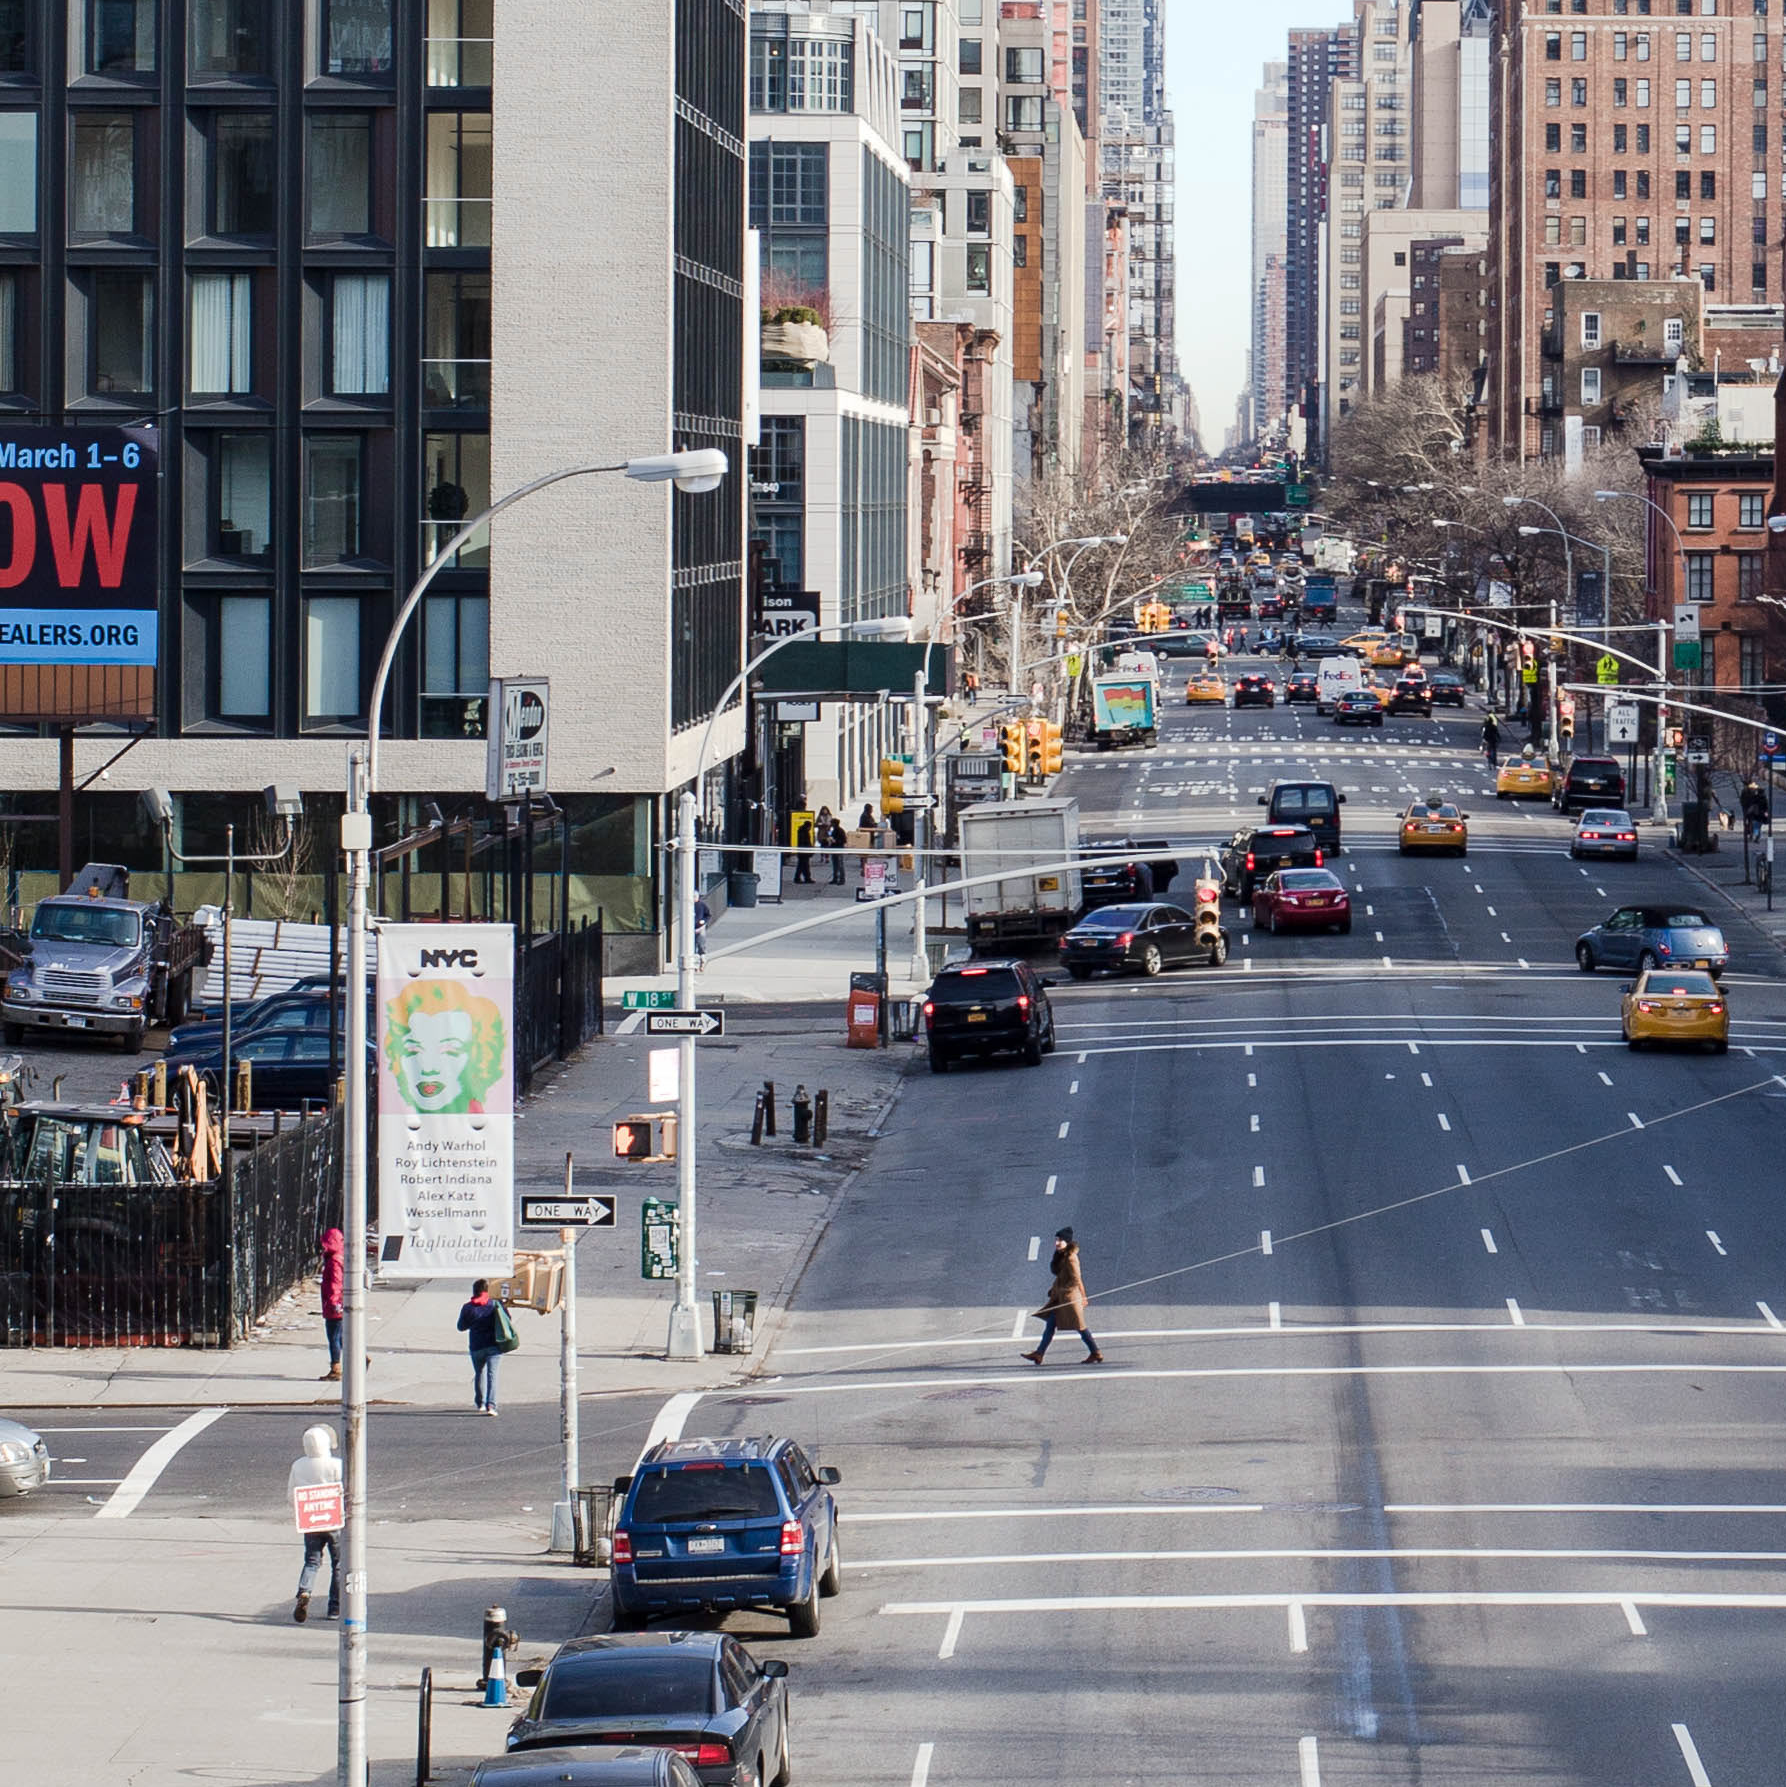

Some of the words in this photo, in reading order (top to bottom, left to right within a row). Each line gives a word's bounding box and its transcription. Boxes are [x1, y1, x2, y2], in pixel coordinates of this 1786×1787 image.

[0, 442, 76, 469] March
[1323, 670, 1353, 681] FedEx
[1612, 717, 1637, 726] TRAFFIC
[420, 949, 478, 968] NYC
[626, 994, 639, 1007] W
[645, 993, 659, 1007] 18
[661, 992, 674, 1001] ST
[657, 1018, 679, 1029] ONE
[688, 1018, 711, 1029] WAY
[407, 1140, 439, 1153] Andy
[442, 1140, 486, 1151] Warhol
[395, 1157, 419, 1170] Roy
[422, 1157, 497, 1168] Lichtenstein
[400, 1174, 442, 1184] Robert
[445, 1174, 492, 1184] Indiana
[417, 1191, 444, 1201] Alex
[447, 1191, 475, 1201] Katz
[406, 1207, 487, 1218] Wessellmann
[534, 1205, 560, 1217] ONE
[573, 1205, 600, 1217] WAY
[409, 1235, 508, 1253] Taglialatella
[454, 1250, 508, 1263] Galleries
